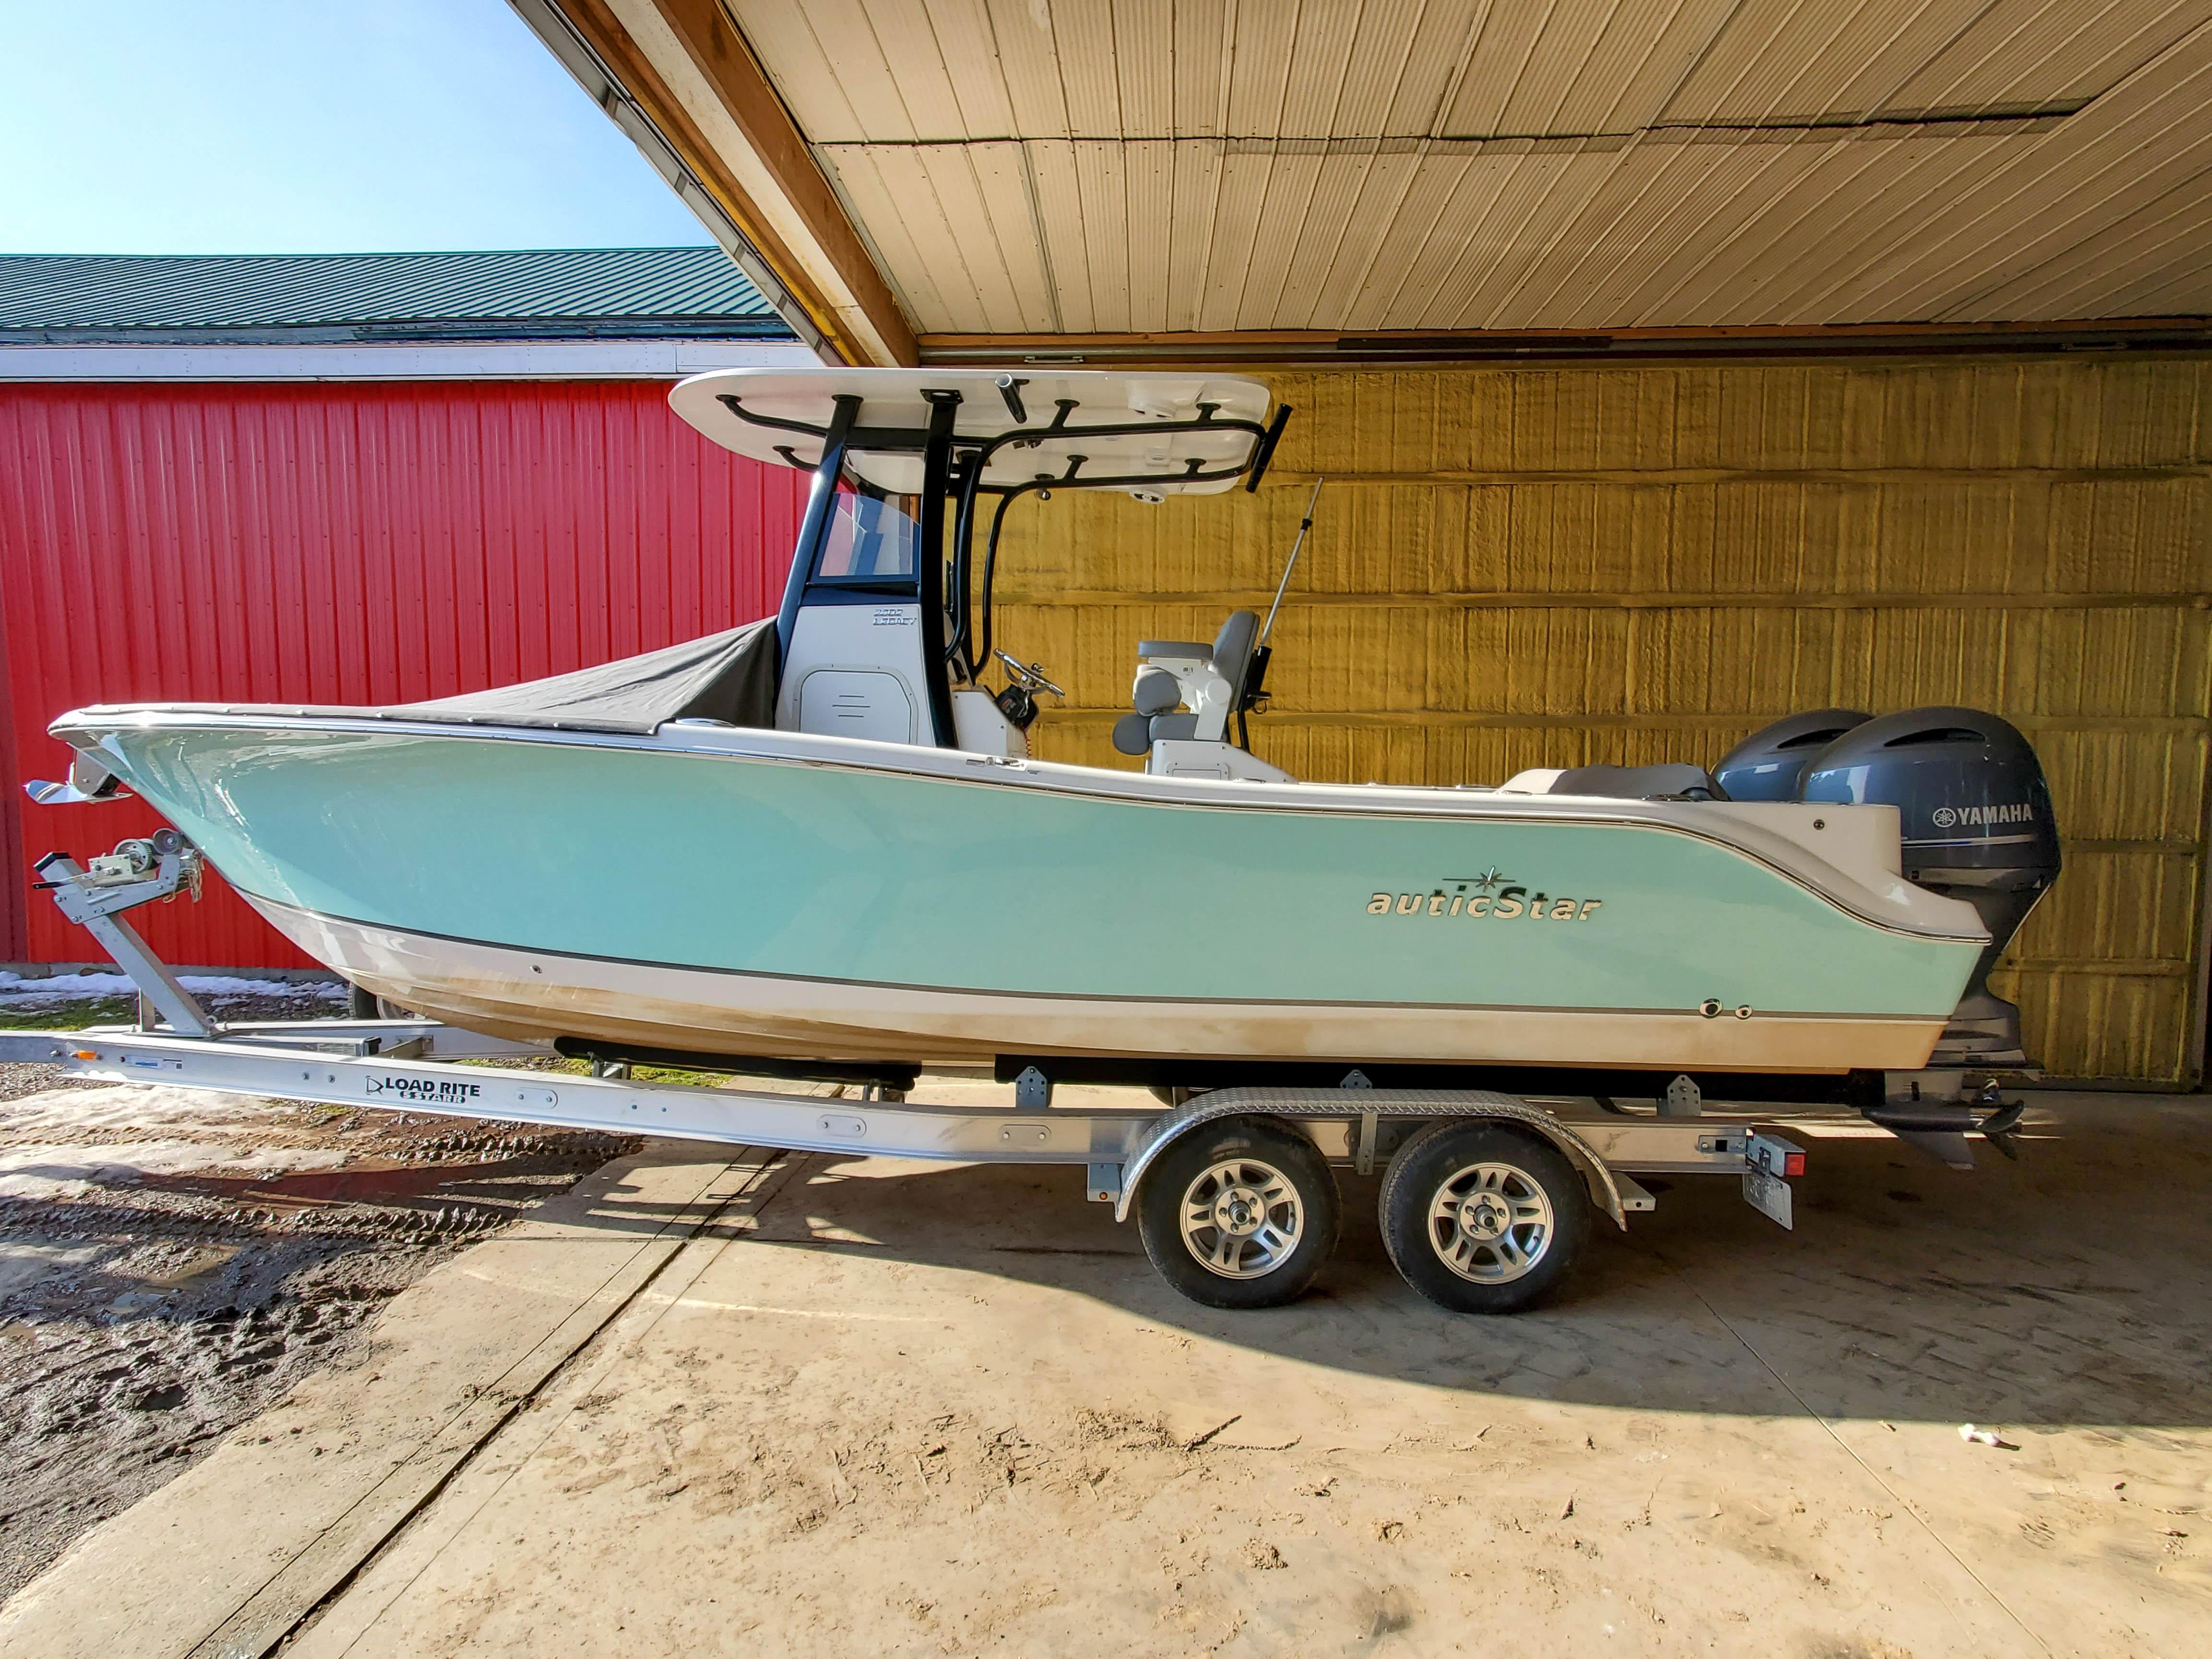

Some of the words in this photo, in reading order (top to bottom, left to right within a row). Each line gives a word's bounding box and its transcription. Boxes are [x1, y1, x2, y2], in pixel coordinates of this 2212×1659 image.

[1957, 804, 2033, 825] YAMAHA
[385, 1077, 435, 1092] LOAD
[440, 1082, 481, 1097] RITE
[413, 1092, 464, 1104] STARR
